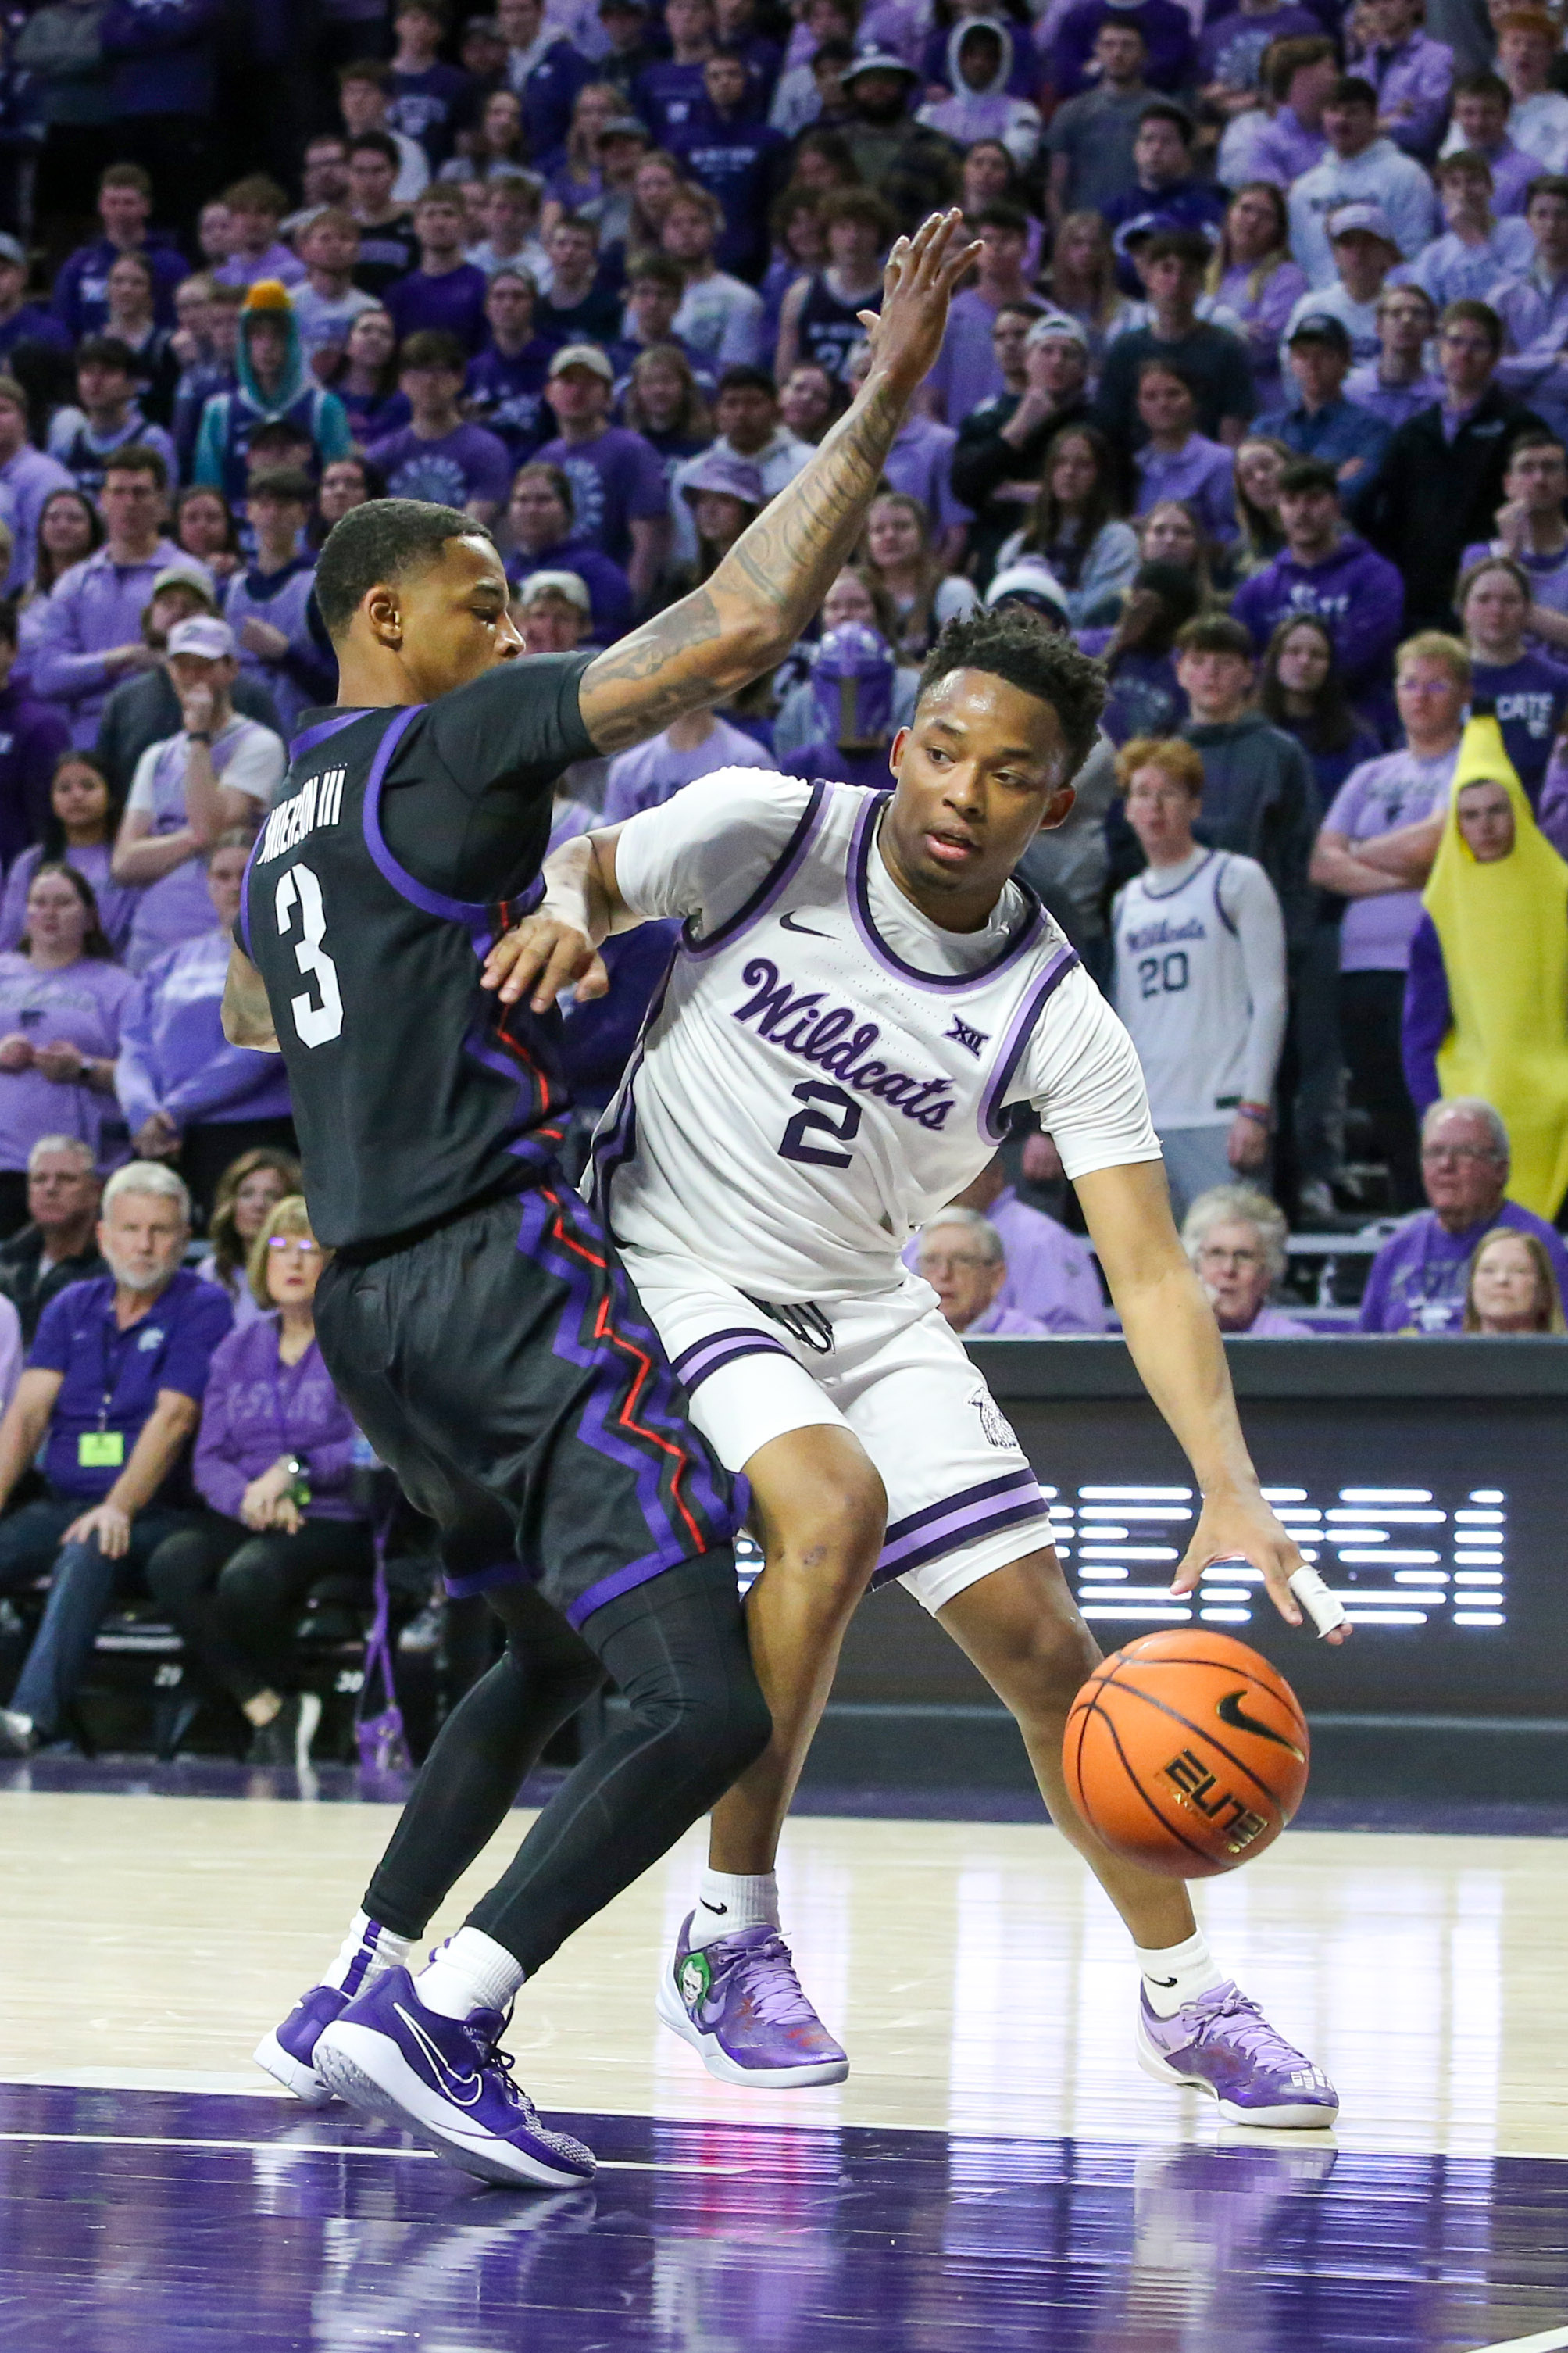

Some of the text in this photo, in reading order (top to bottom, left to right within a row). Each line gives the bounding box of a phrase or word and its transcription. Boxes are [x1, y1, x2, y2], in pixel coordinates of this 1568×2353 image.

[316, 769, 345, 828] III
[275, 863, 344, 1049] 3
[1138, 951, 1188, 999] 20
[730, 958, 956, 1131] Wildcats
[777, 1080, 862, 1168] 2
[1163, 1748, 1269, 1847] ELITE
